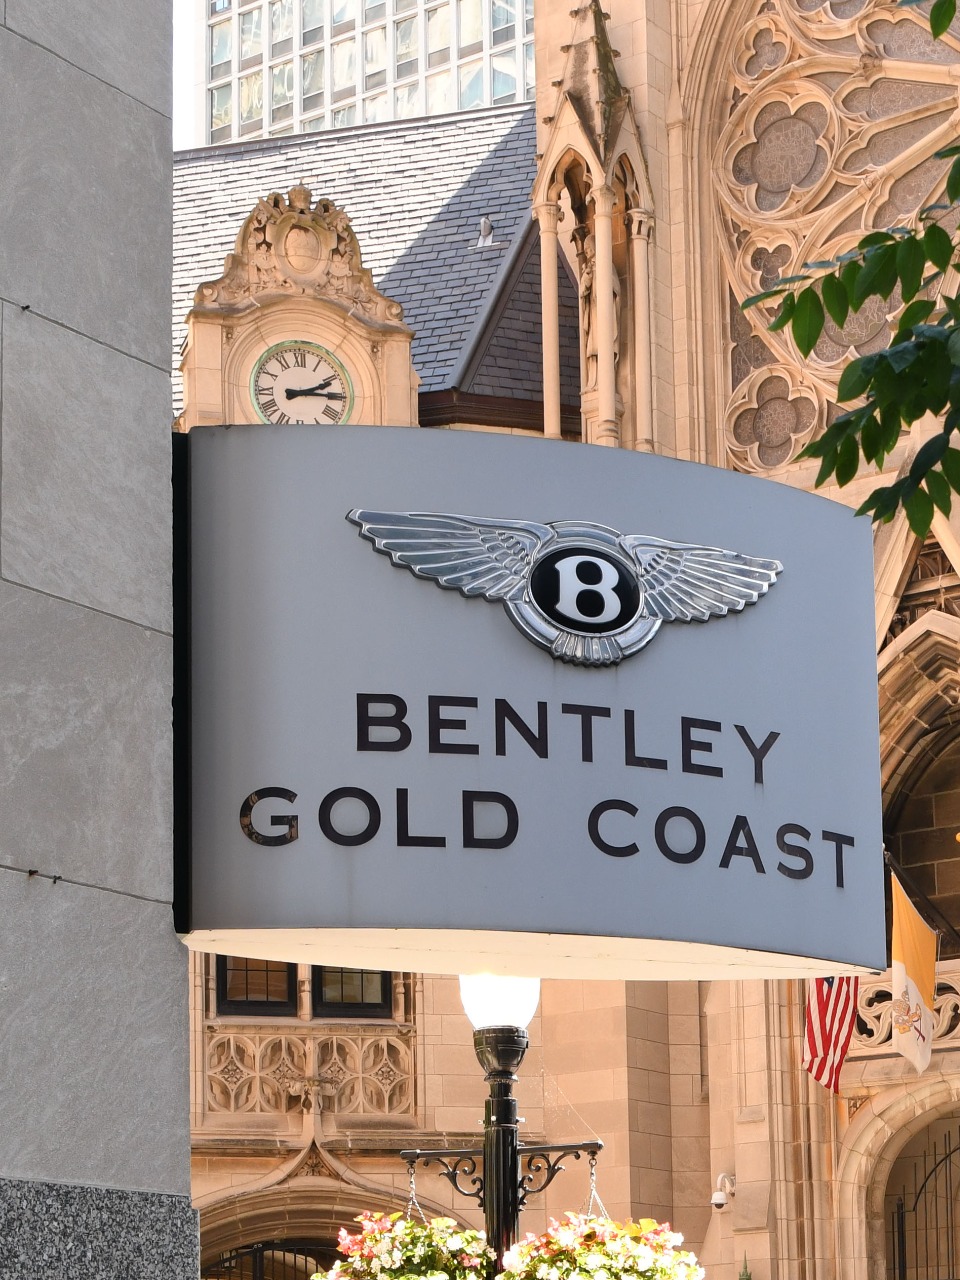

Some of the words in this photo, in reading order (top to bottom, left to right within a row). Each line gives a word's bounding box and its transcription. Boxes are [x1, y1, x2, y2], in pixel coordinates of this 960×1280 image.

[356, 692, 781, 785] BENTLEY
[239, 786, 520, 850] GOLD
[587, 798, 855, 889] COAST
